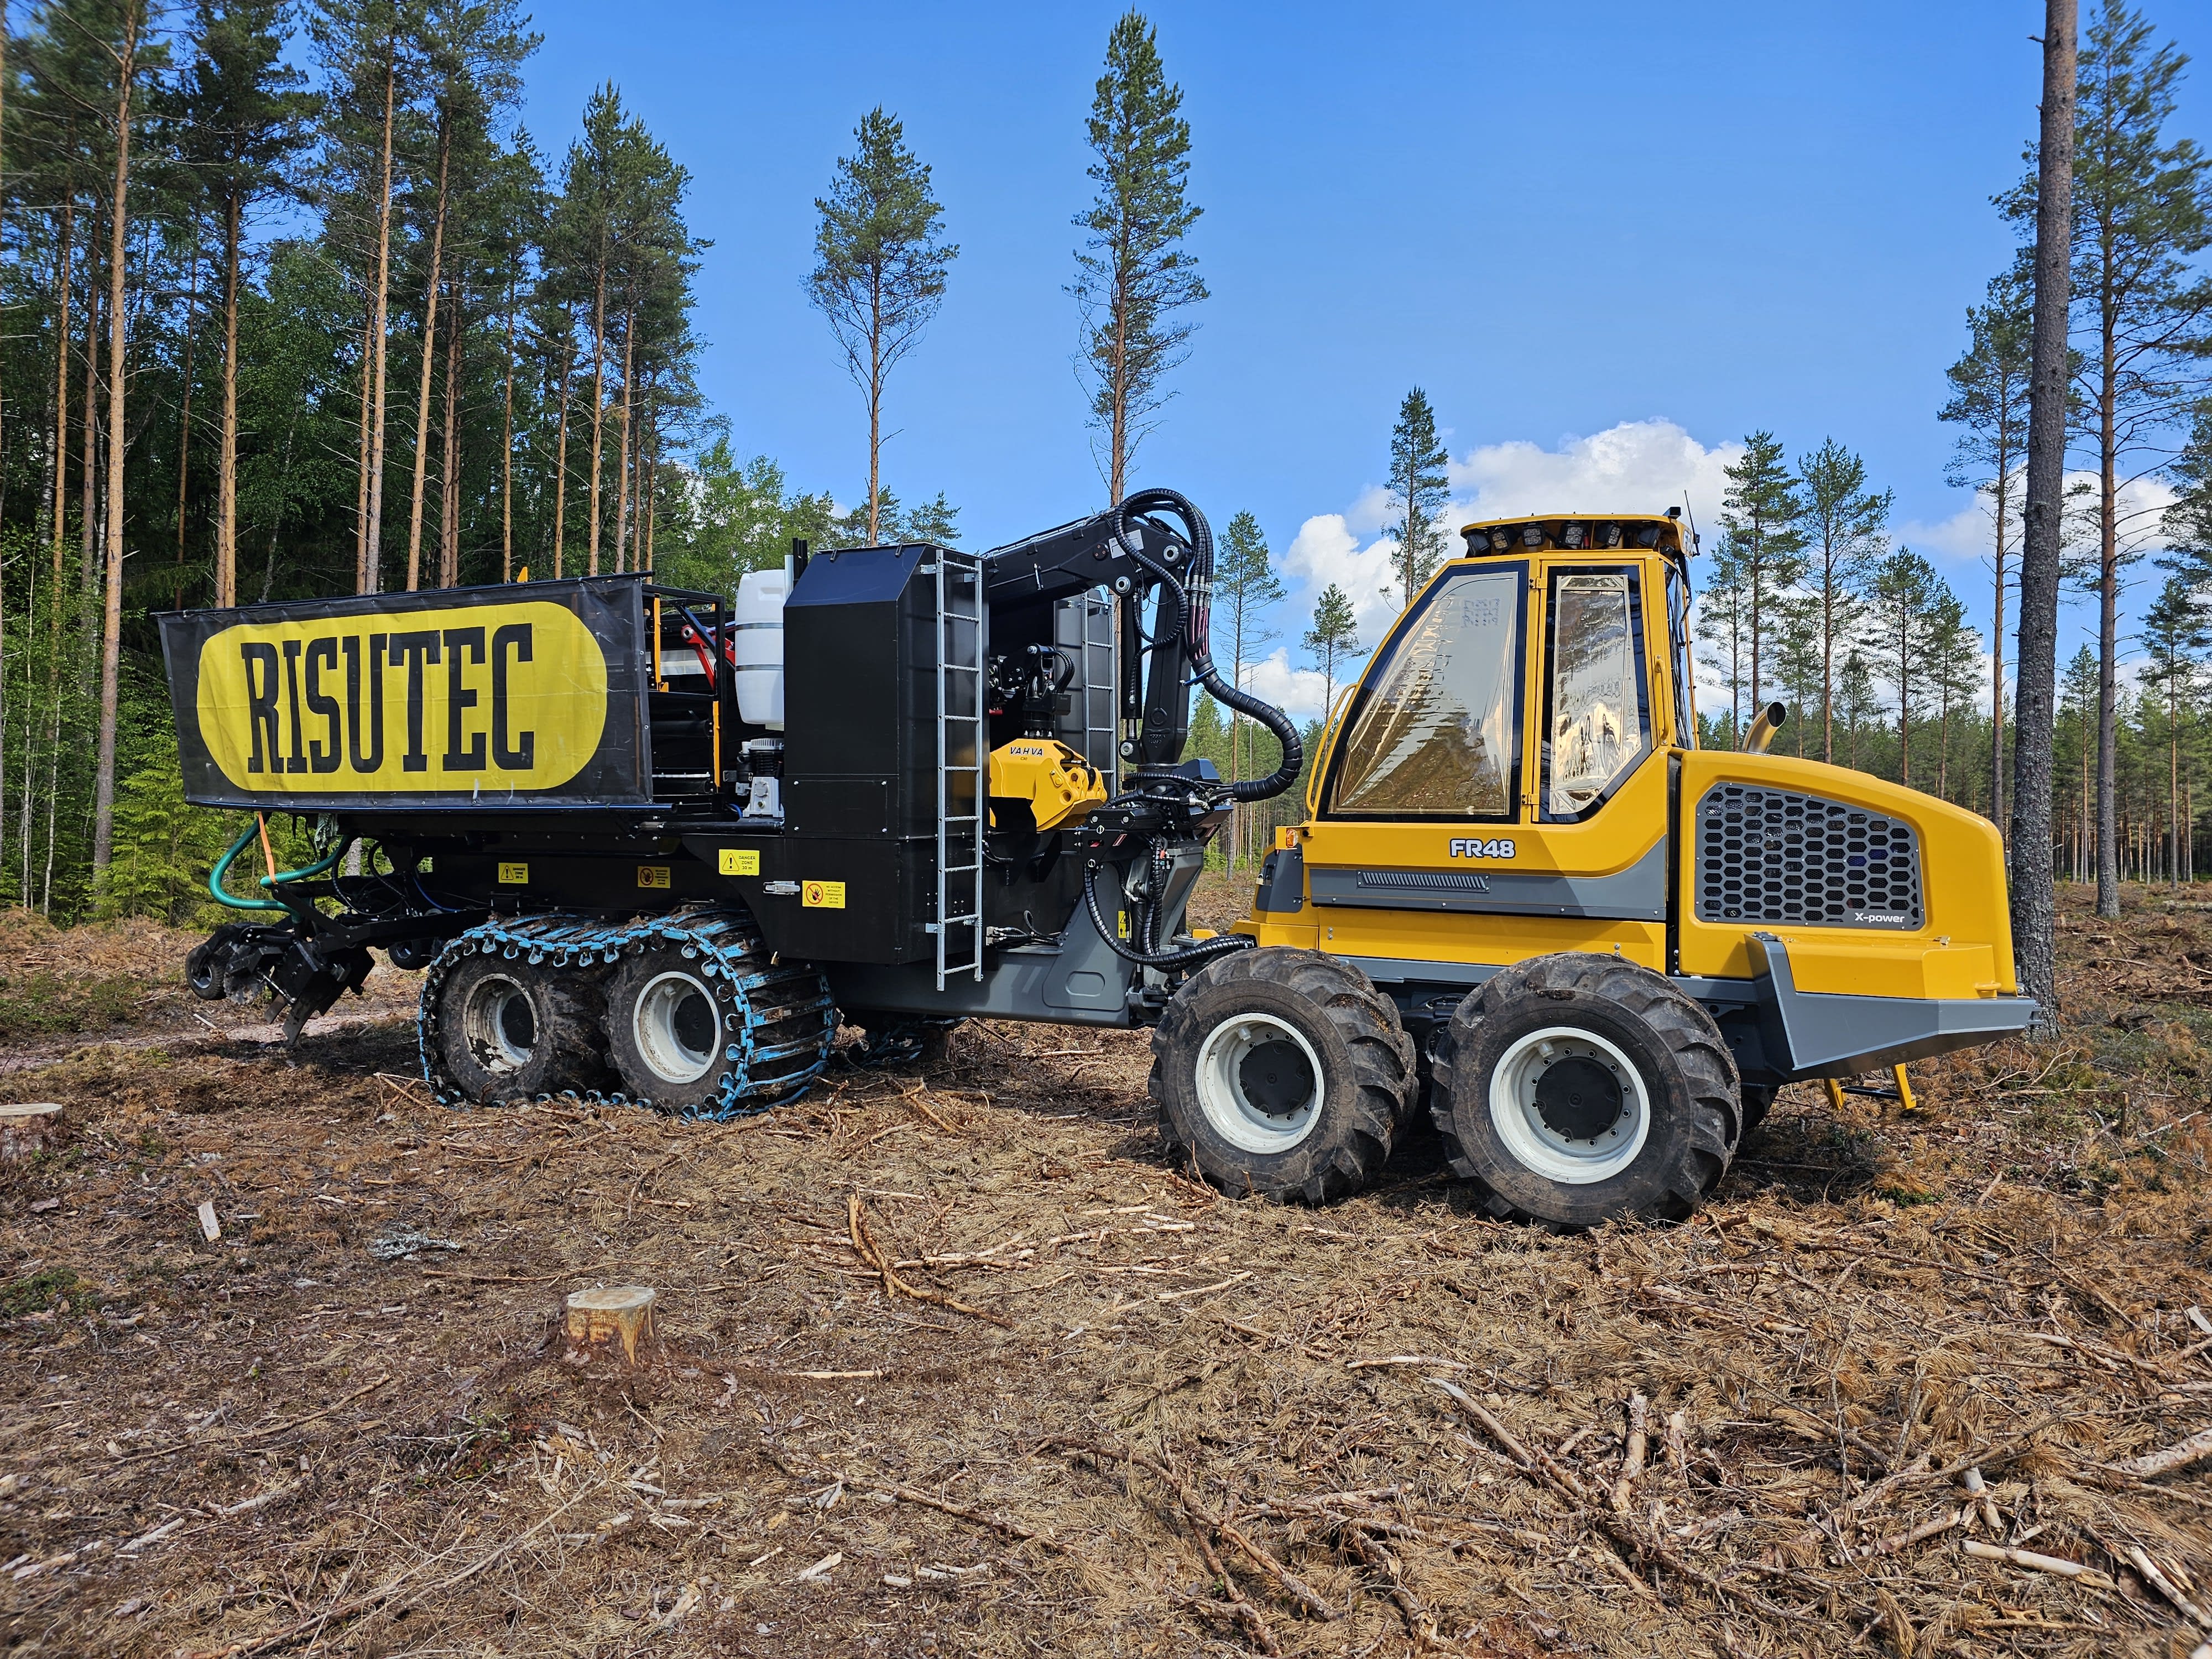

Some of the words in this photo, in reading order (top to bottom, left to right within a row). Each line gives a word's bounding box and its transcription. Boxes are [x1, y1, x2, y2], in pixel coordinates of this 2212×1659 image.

[241, 623, 534, 774] RISUTEC
[1010, 747, 1043, 756] VAHVA
[1450, 838, 1516, 858] FR48
[1854, 912, 1905, 923] X-power
